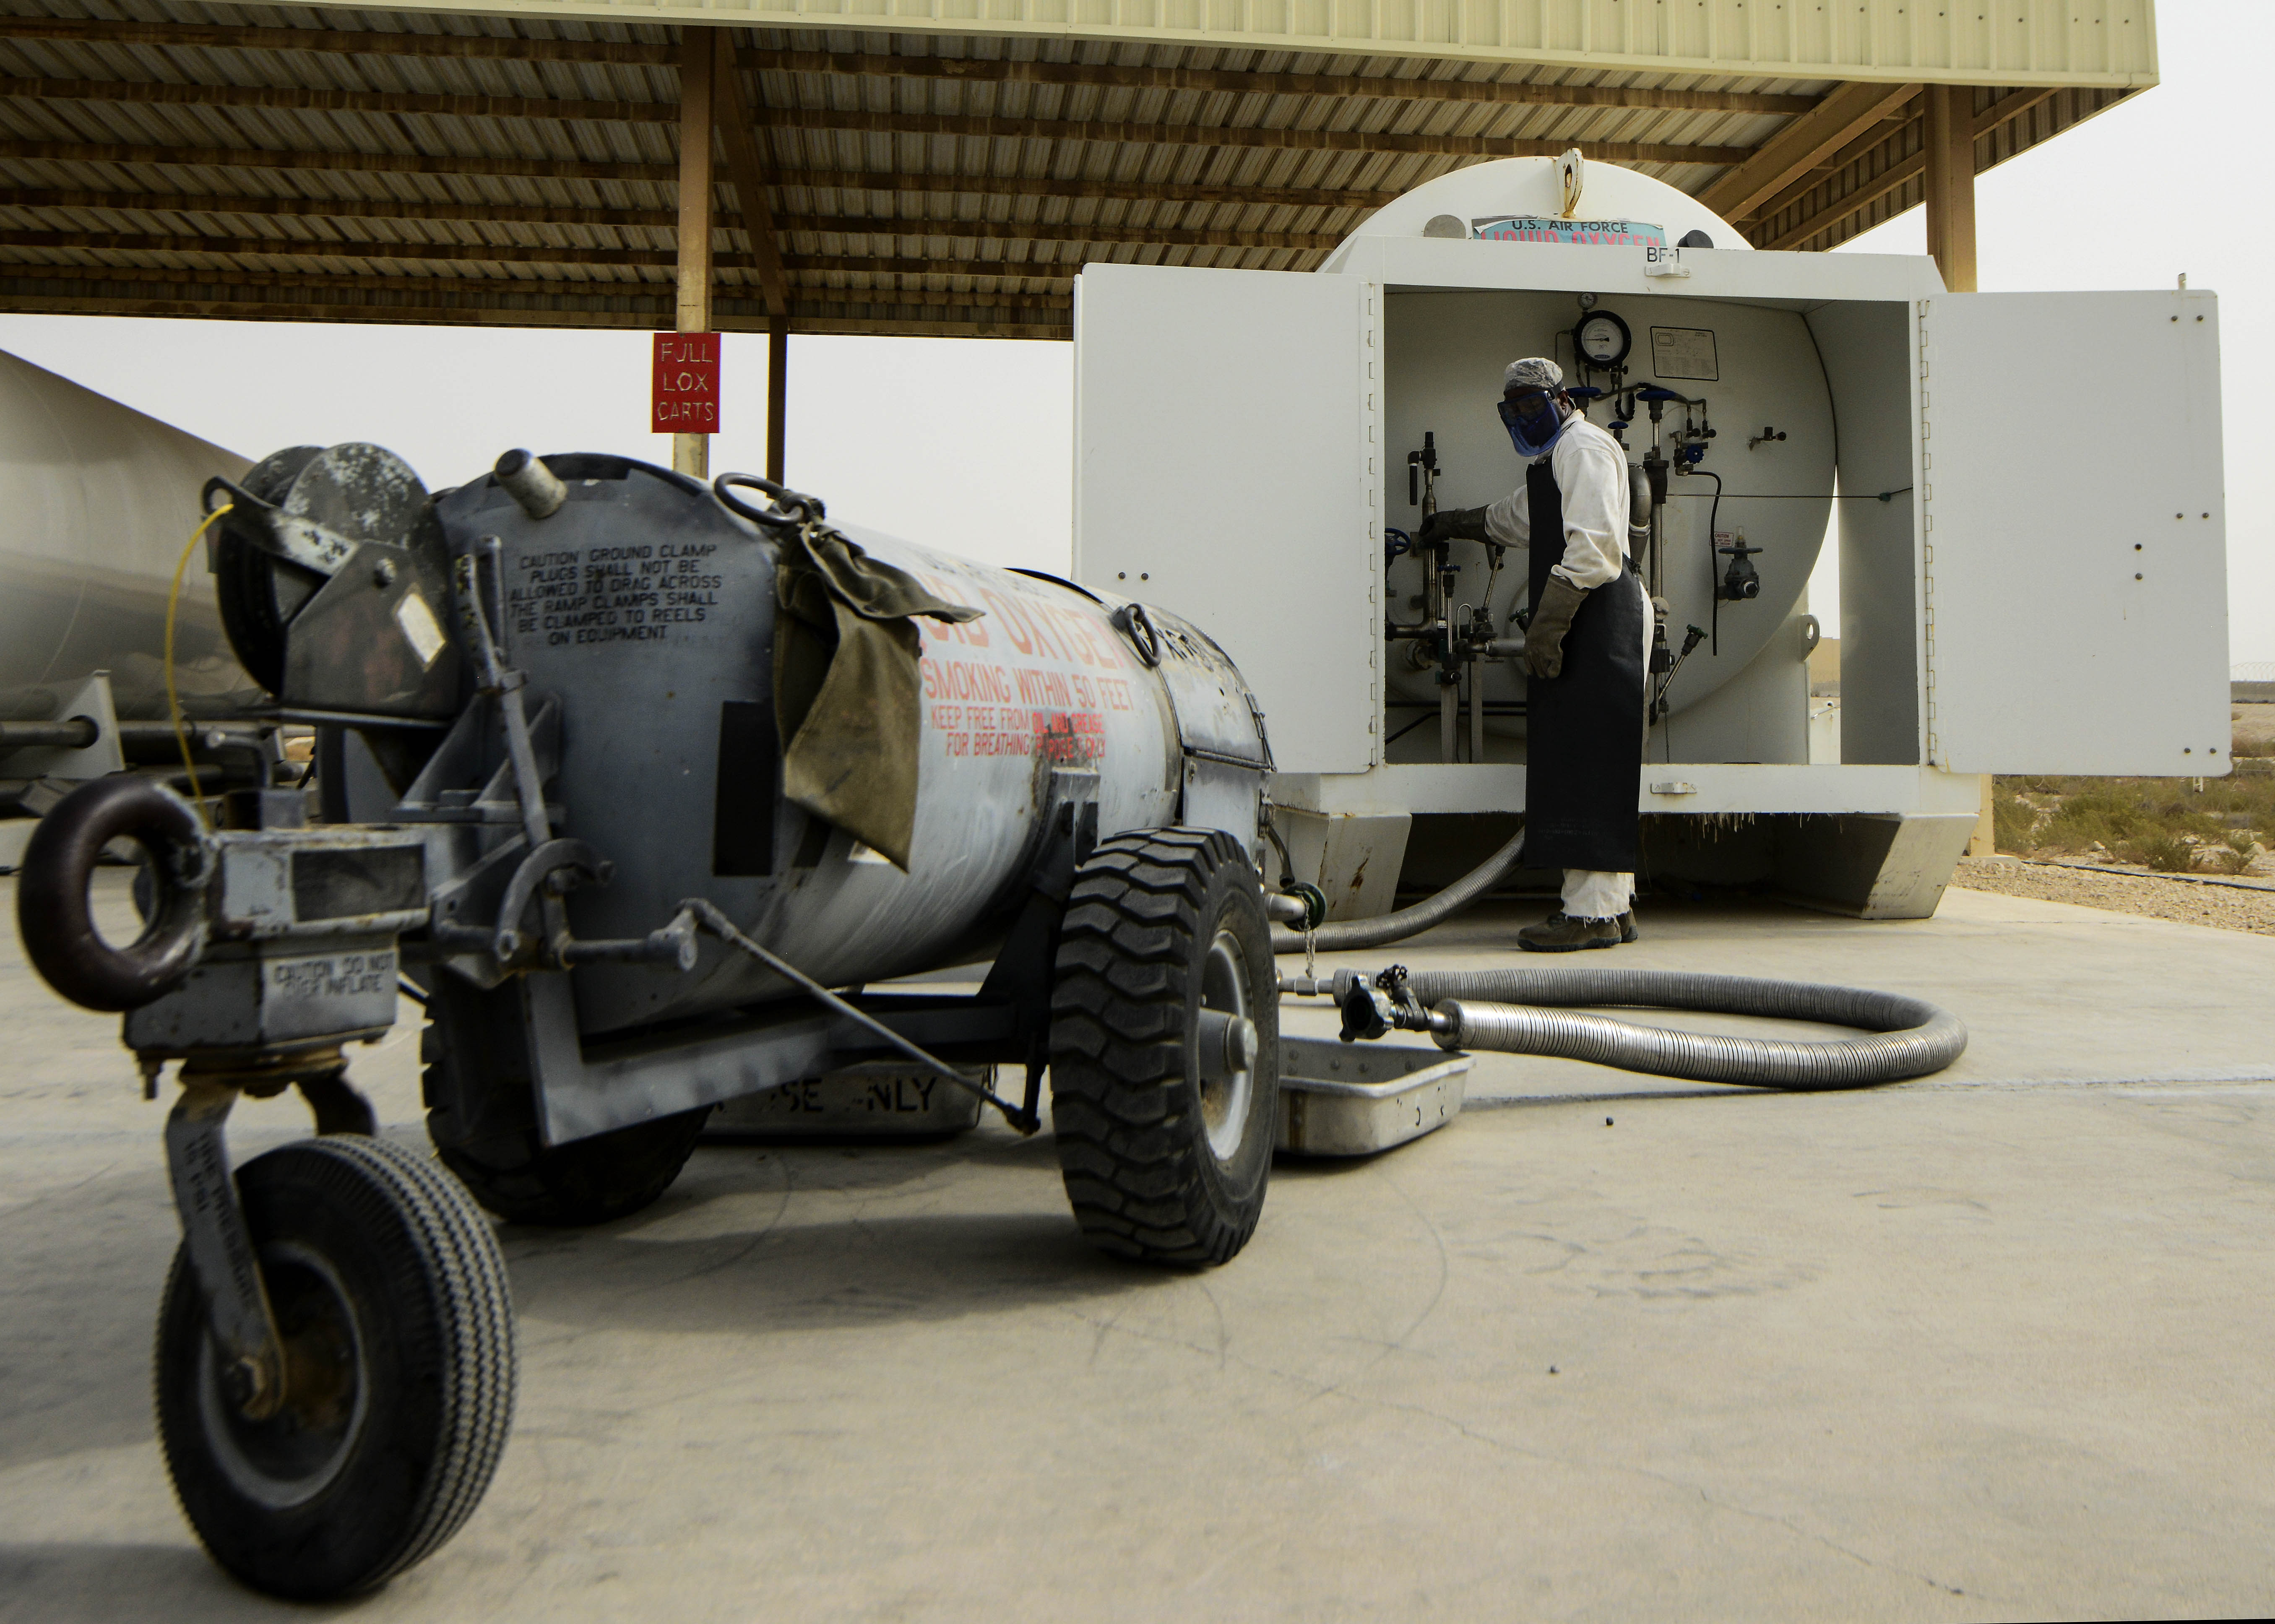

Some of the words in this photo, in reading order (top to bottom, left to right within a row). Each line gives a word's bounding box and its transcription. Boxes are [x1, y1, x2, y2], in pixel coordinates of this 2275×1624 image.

[1512, 220, 1541, 230] U.S.
[1549, 221, 1573, 231] AIR
[1580, 223, 1628, 233] FORCE
[1647, 247, 1679, 263] BF-1
[661, 343, 713, 362] FULL
[663, 372, 708, 392] LOX
[657, 401, 715, 421] CARTS
[520, 551, 580, 569] CAUTION
[589, 545, 653, 562] GROUND
[659, 543, 718, 558] CLAMP
[530, 566, 578, 583] PLUGS
[585, 562, 633, 578] SHALL
[640, 560, 672, 574] NOT
[678, 559, 701, 573] BE
[509, 582, 578, 601] ALLOWED
[585, 580, 604, 594] TO
[611, 576, 652, 592] DRAG
[658, 574, 722, 589] ACROSS
[510, 601, 538, 618] THE
[544, 596, 588, 613] RAMP
[592, 592, 659, 609] CLAMPS
[666, 590, 719, 605] SHALL
[518, 617, 539, 633] BE
[543, 610, 618, 630] CLAMPED
[625, 609, 645, 623] TO
[652, 607, 707, 623] REELS
[978, 588, 1136, 669] OXYGEN
[548, 630, 571, 646] ON
[576, 625, 668, 644] EQUIPMENT
[920, 657, 1011, 703] SMOKING
[1013, 667, 1072, 707] WITHIN
[1071, 674, 1096, 708] 50
[1096, 676, 1135, 711] FEET
[931, 705, 963, 729] KEEP
[966, 706, 996, 730] FREE
[1000, 707, 1030, 731] FROM
[1032, 712, 1049, 734] OIL
[1051, 712, 1069, 734] AND
[1071, 713, 1105, 734] GREASE
[946, 732, 969, 757] FOR
[974, 732, 1030, 757] BREATHING
[847, 1077, 938, 1112] NLY
